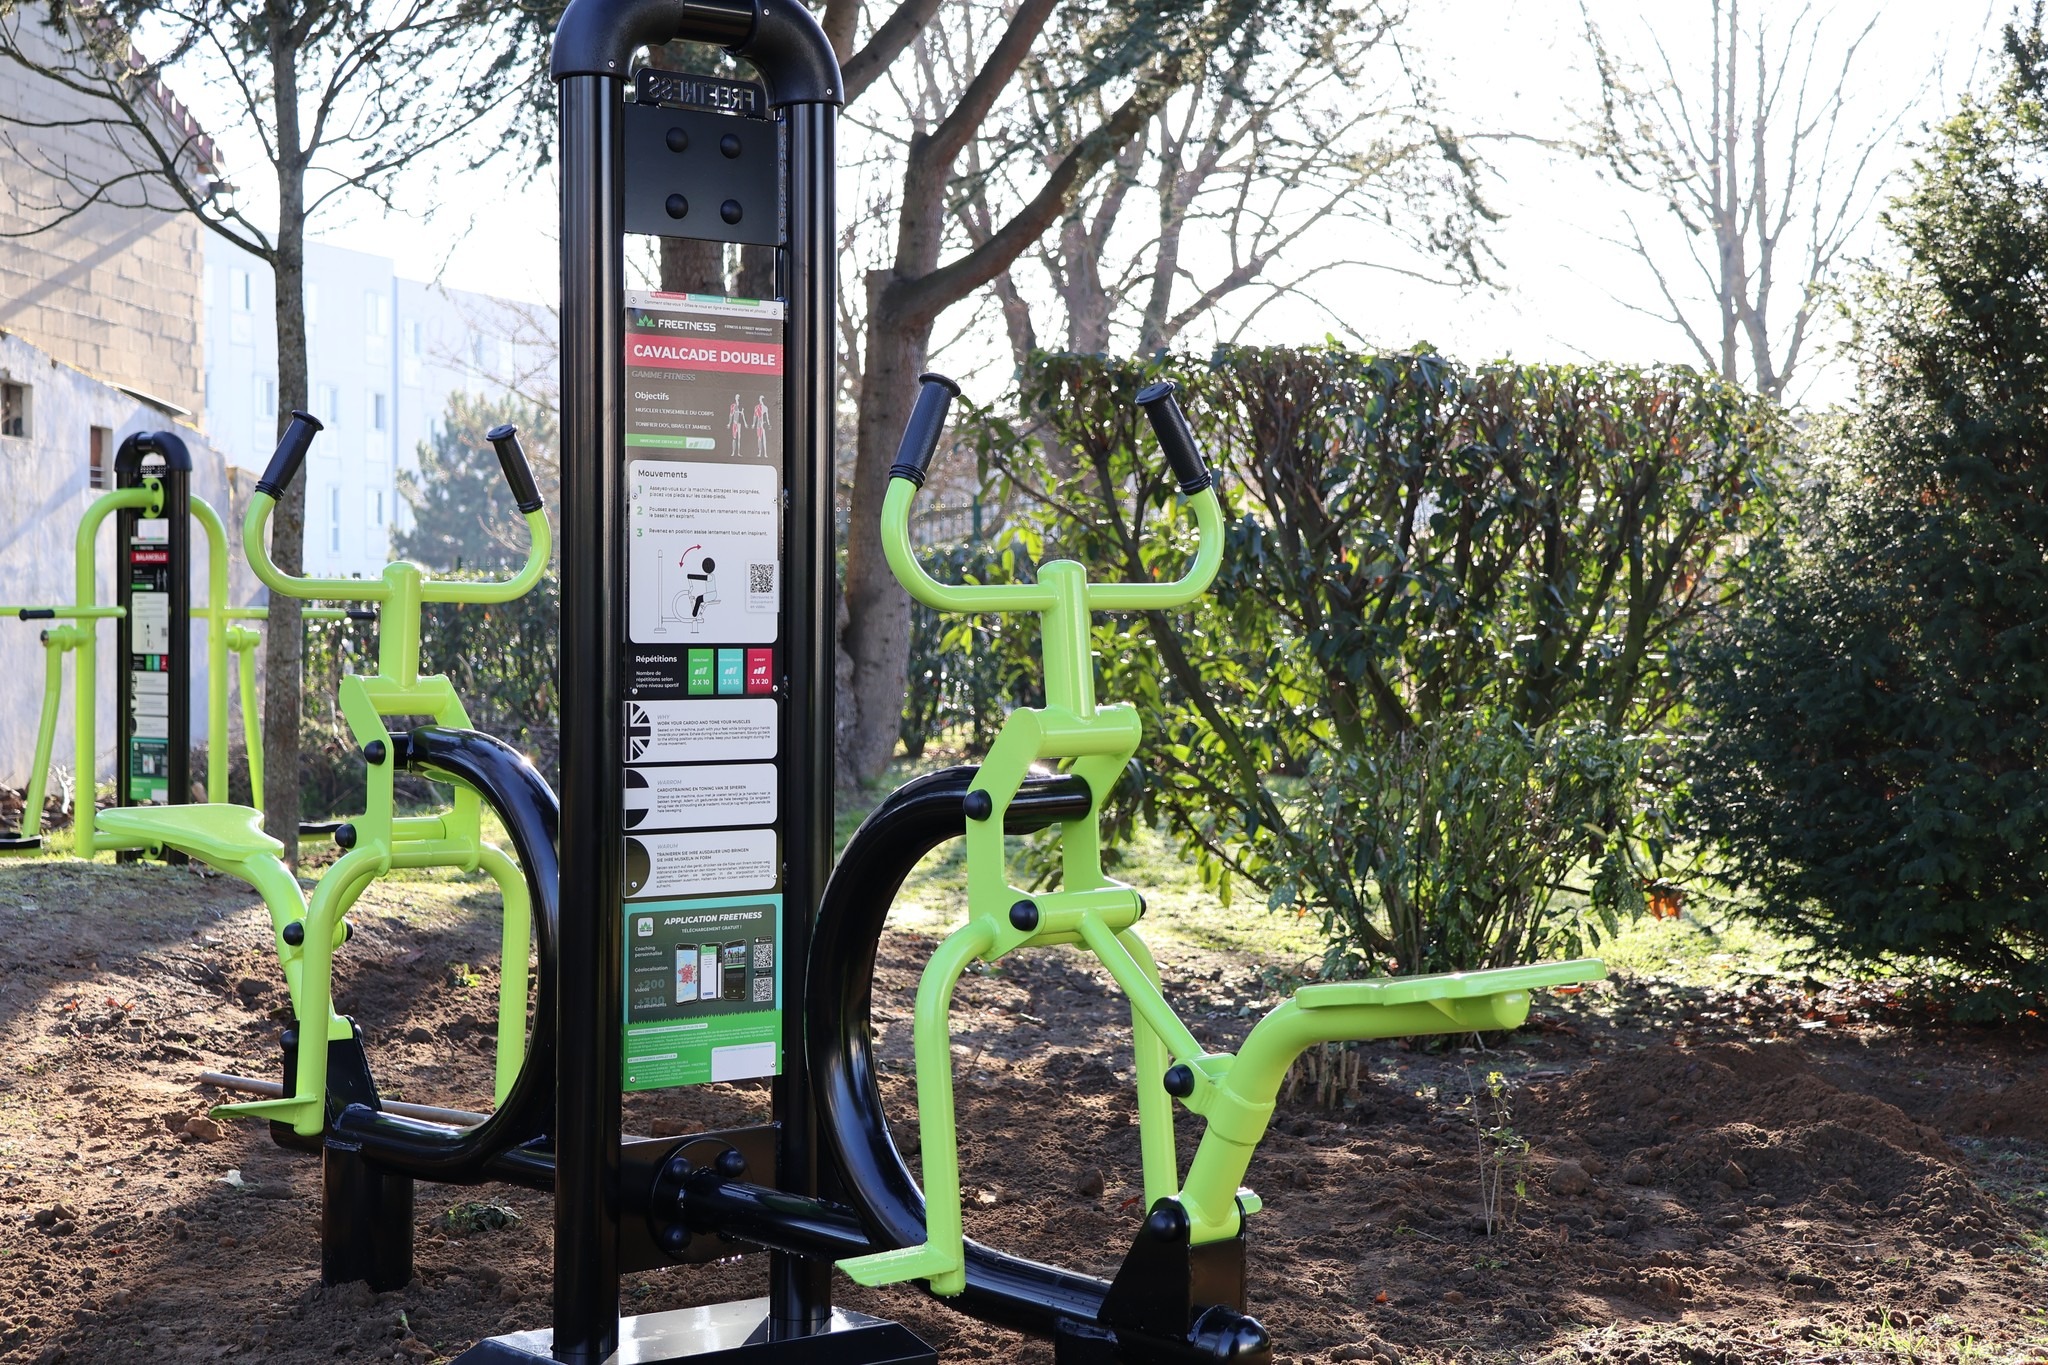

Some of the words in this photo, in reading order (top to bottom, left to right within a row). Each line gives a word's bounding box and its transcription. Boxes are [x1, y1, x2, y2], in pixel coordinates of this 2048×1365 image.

[658, 318, 716, 332] FREETNESS
[633, 344, 717, 362] CAVALCADE
[720, 351, 776, 366] DOUBLE
[632, 370, 661, 379] GAMME
[663, 372, 696, 381] FITNESS
[634, 391, 670, 401] Objectifs
[638, 469, 688, 479] Mouvements
[638, 485, 642, 494] 1
[636, 506, 643, 515] 2
[636, 528, 643, 537] 3
[635, 655, 678, 664] Répétitions
[664, 914, 718, 925] APPLICATION
[718, 911, 763, 922] FREETNESS
[681, 925, 721, 934] TÉLÉCHARGEMENT
[634, 950, 663, 958] personnalisé
